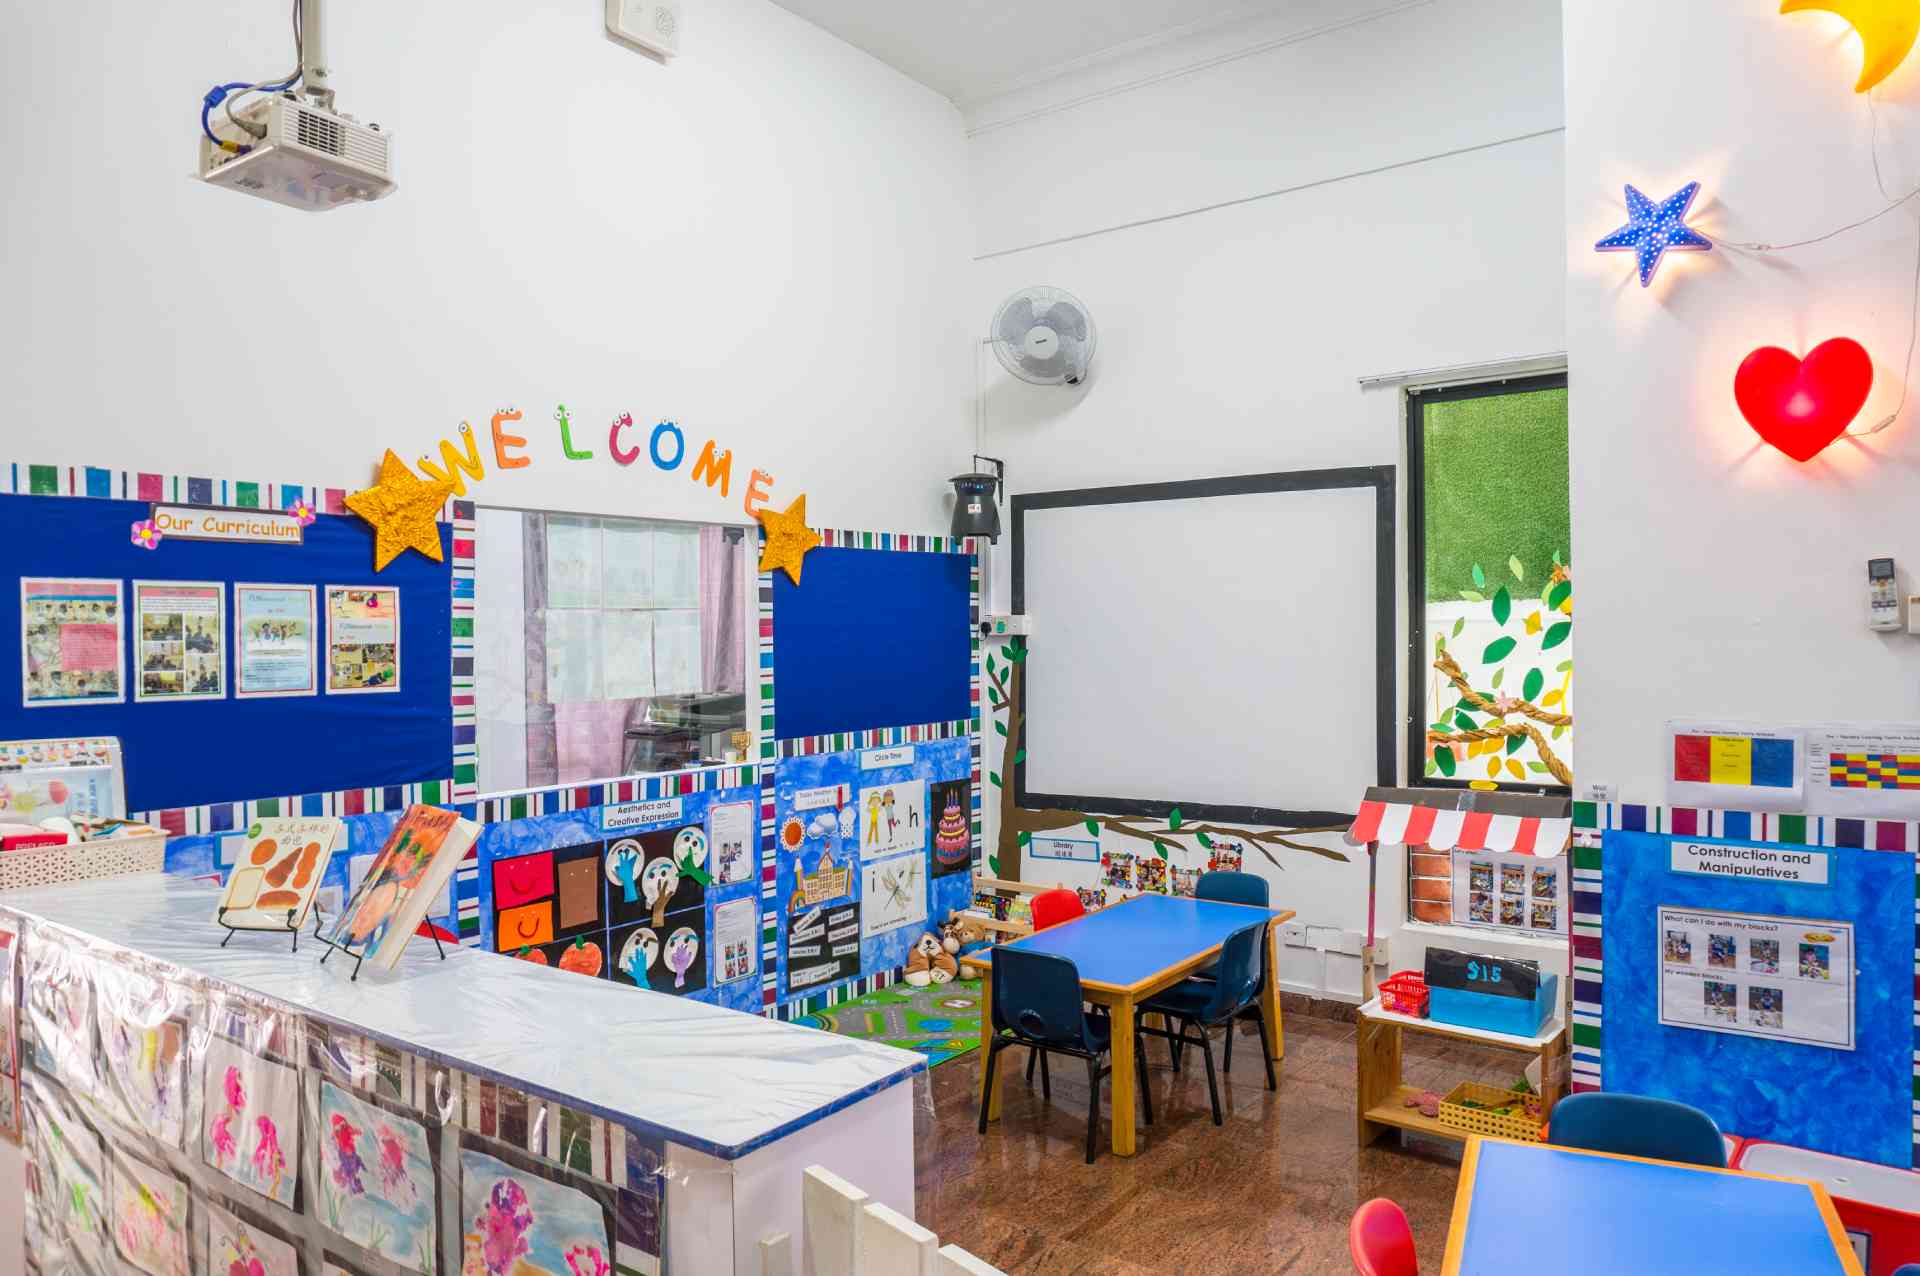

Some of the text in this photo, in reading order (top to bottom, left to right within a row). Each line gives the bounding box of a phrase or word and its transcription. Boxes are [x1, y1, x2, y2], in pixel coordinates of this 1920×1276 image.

[416, 403, 774, 518] WELCOME
[155, 513, 299, 537] Our Curriculum
[617, 801, 671, 815] Aesthetics and
[908, 804, 919, 828] h
[607, 811, 679, 827] Creative Expression
[1687, 844, 1811, 865] Construction and
[1699, 861, 1800, 880] Manipulatives
[1664, 914, 1683, 923] What
[1684, 917, 1700, 925] can
[1718, 920, 1733, 928] with
